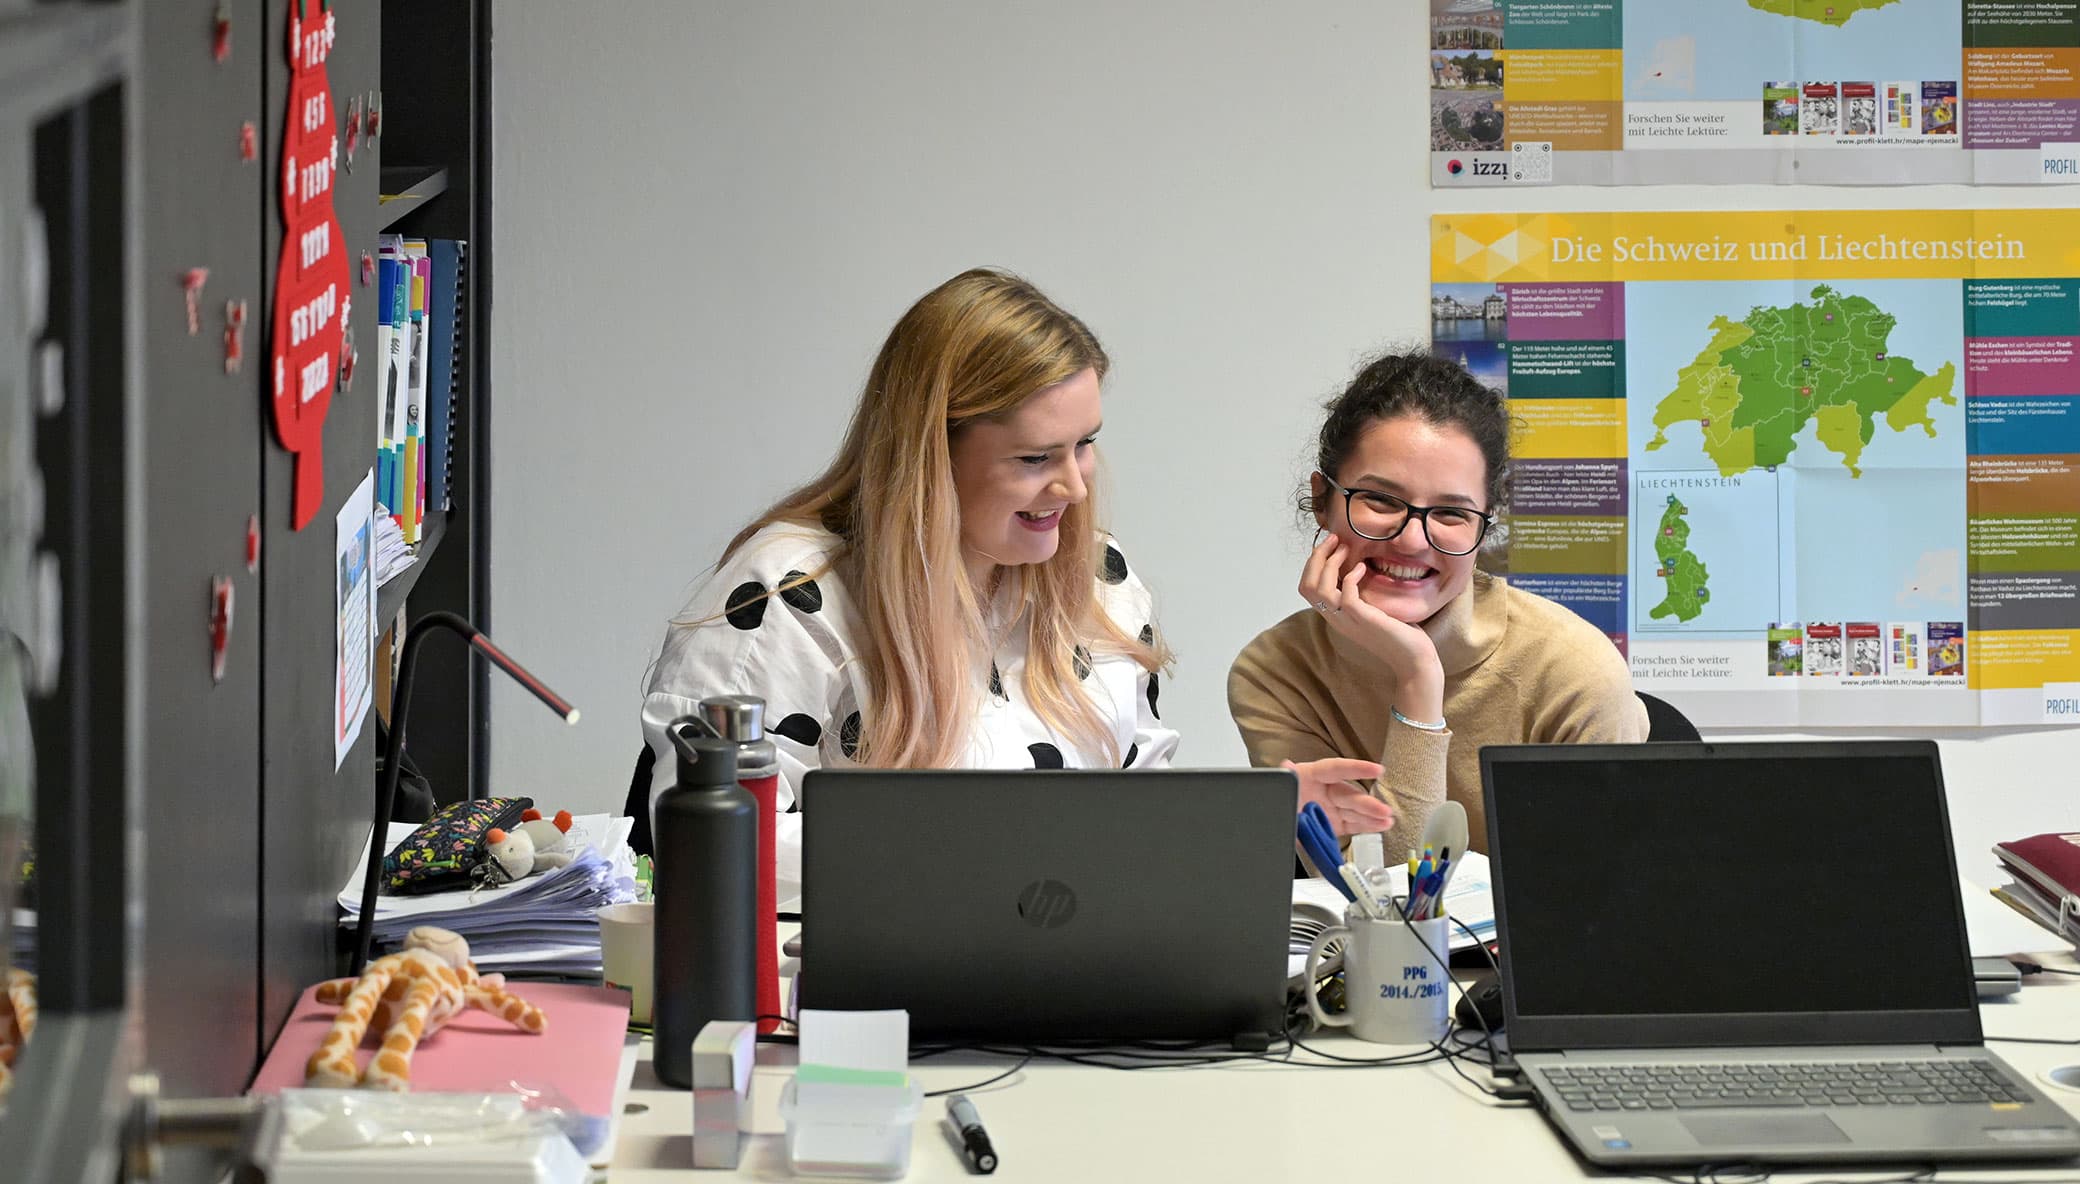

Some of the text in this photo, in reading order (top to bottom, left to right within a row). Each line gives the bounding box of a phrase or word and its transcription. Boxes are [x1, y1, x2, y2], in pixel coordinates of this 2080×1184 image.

[305, 28, 326, 68] 123
[1628, 114, 1725, 123] Forschen Sie weiter
[1628, 127, 1728, 136] mit Leichte Lektüre:
[1836, 137, 1958, 145] www.profil-klett.hr/mape-njemacki
[2044, 160, 2079, 174] PROFIL
[1551, 232, 2027, 262] Die Schweiz und Liechtenstein
[1641, 479, 1741, 488] LIECHTENSTEIN
[1632, 656, 1730, 665] Forschen Sie weiter
[1632, 668, 1649, 677] mit
[1652, 668, 1688, 677] Leichte
[1841, 679, 1966, 687] www.profil-klett.hr/mape-njemacki
[2046, 699, 2080, 714] PROFIL
[1403, 966, 1427, 980] PPG
